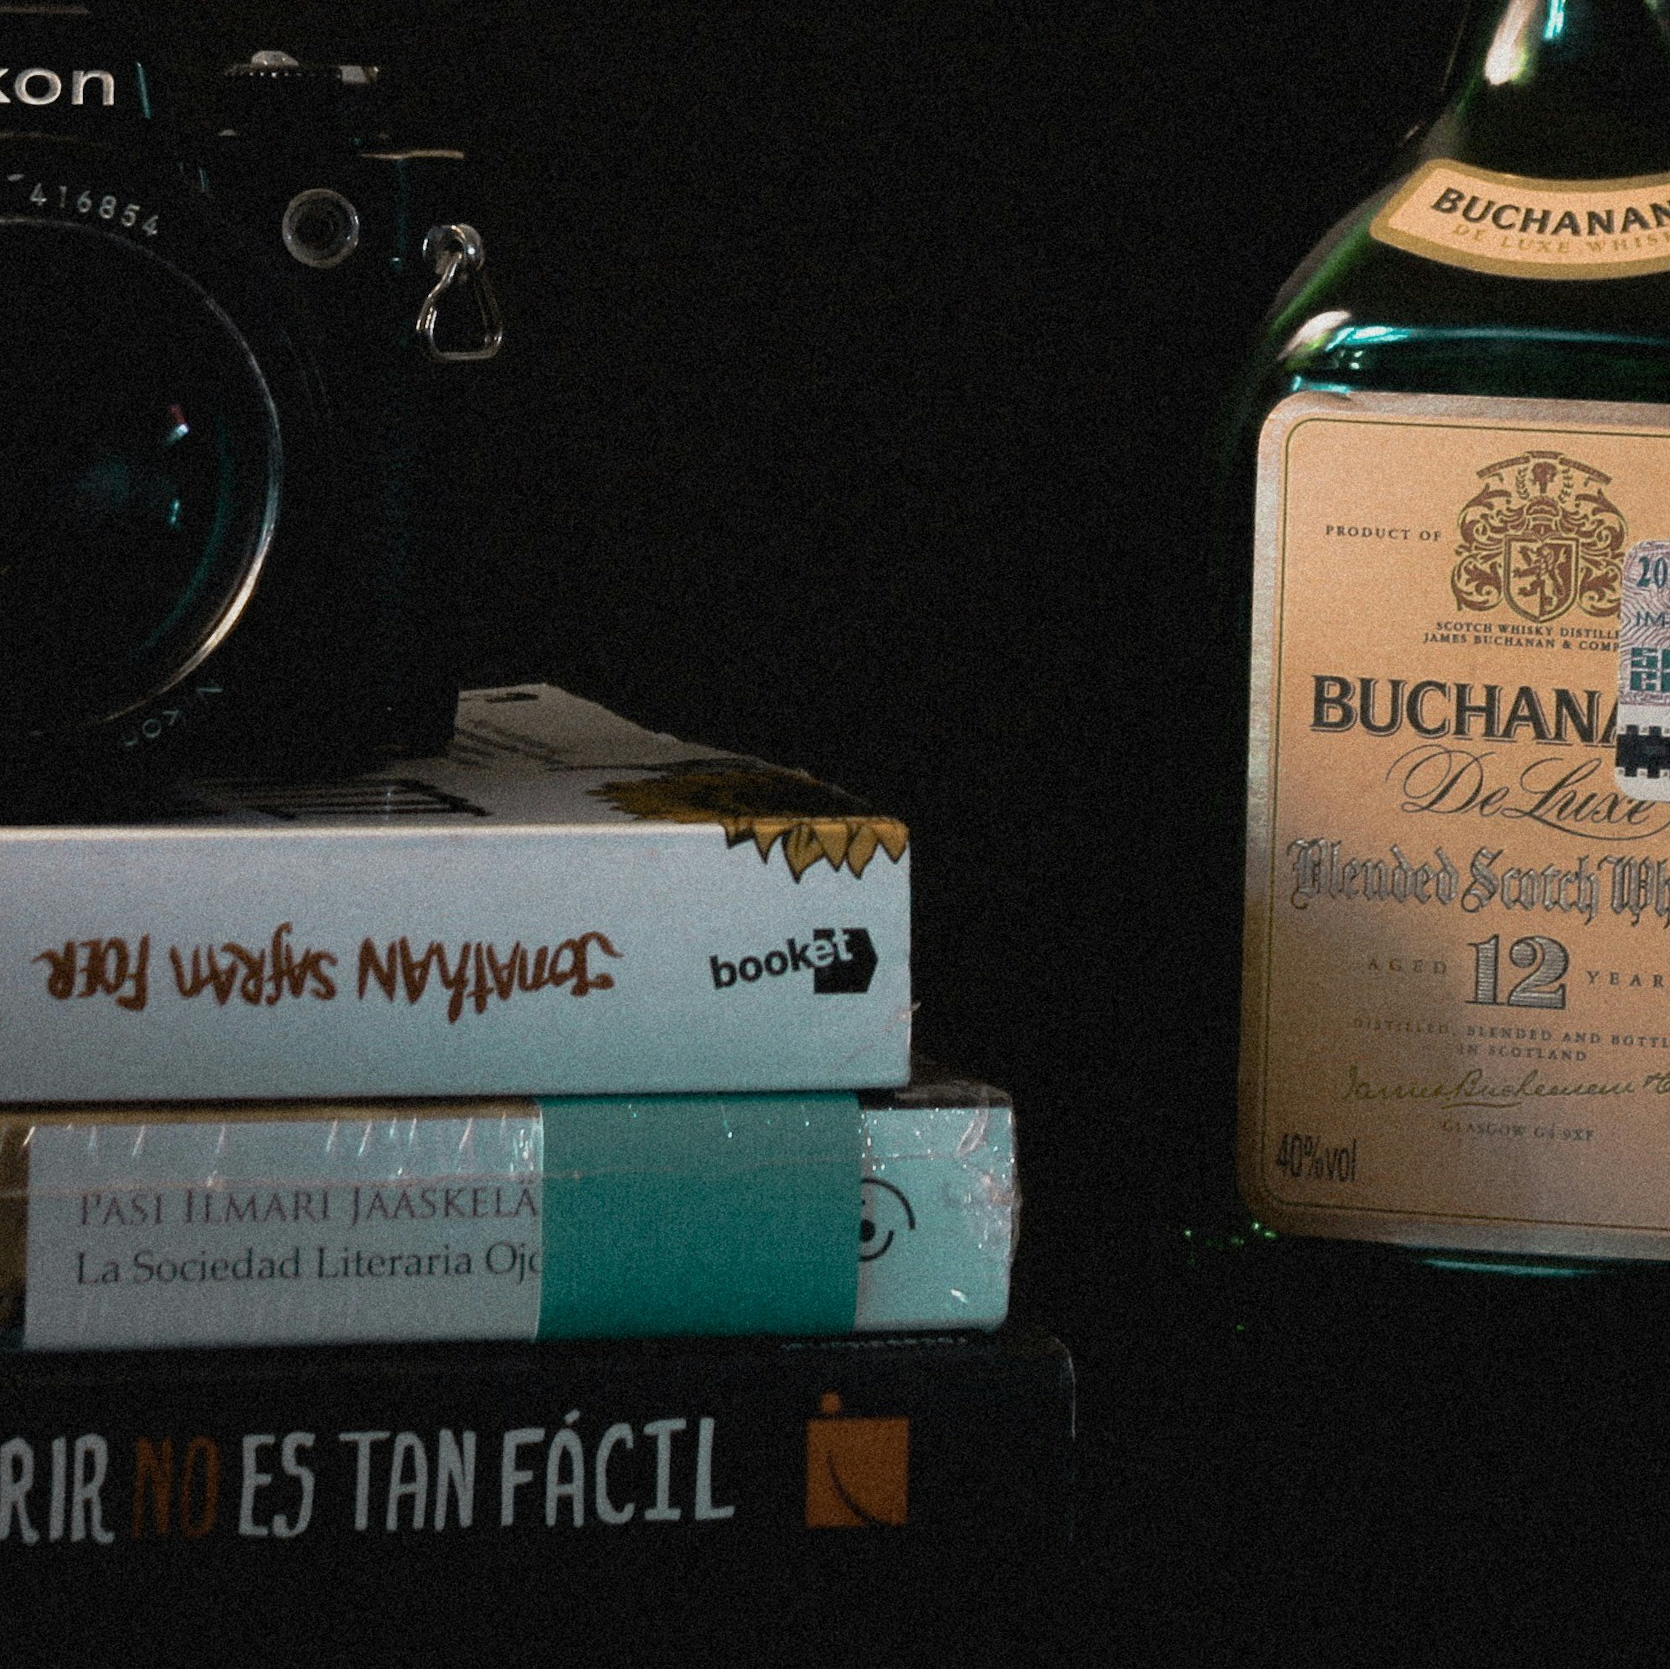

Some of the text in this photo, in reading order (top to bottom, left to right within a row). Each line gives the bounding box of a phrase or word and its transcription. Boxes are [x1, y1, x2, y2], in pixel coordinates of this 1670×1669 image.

[28, 183, 161, 238] 416854
[1451, 222, 1484, 242] DE
[1500, 234, 1571, 255] LUXE
[1324, 523, 1443, 543] PRODUCT OF
[1422, 631, 1467, 644] JAMES
[1473, 634, 1556, 648] BUCHANAN
[1562, 639, 1573, 650] &
[1436, 620, 1493, 633] SCOTCH
[1498, 623, 1554, 636] WHISKY
[1285, 836, 1459, 911] Blended
[1460, 845, 1600, 924] Scotch
[31, 934, 151, 1013] FOER
[708, 926, 854, 991] booket
[1365, 956, 1449, 976] AGED
[1463, 932, 1571, 1011] 12
[1457, 1043, 1588, 1062] IN SCOTLAND
[1466, 1025, 1553, 1042] BLENDED
[1561, 1029, 1602, 1045] AND
[1441, 1121, 1523, 1138] GLASGOW
[79, 1192, 164, 1227] PASI
[183, 1189, 331, 1225] ILMARI
[76, 1250, 121, 1286] La
[132, 1245, 302, 1285] Sociedad
[316, 1245, 473, 1279] Literaria
[130, 1435, 223, 1542] NO
[238, 1430, 318, 1539] ES
[338, 1427, 478, 1535] TAN
[499, 1408, 737, 1530] FÁCIL
